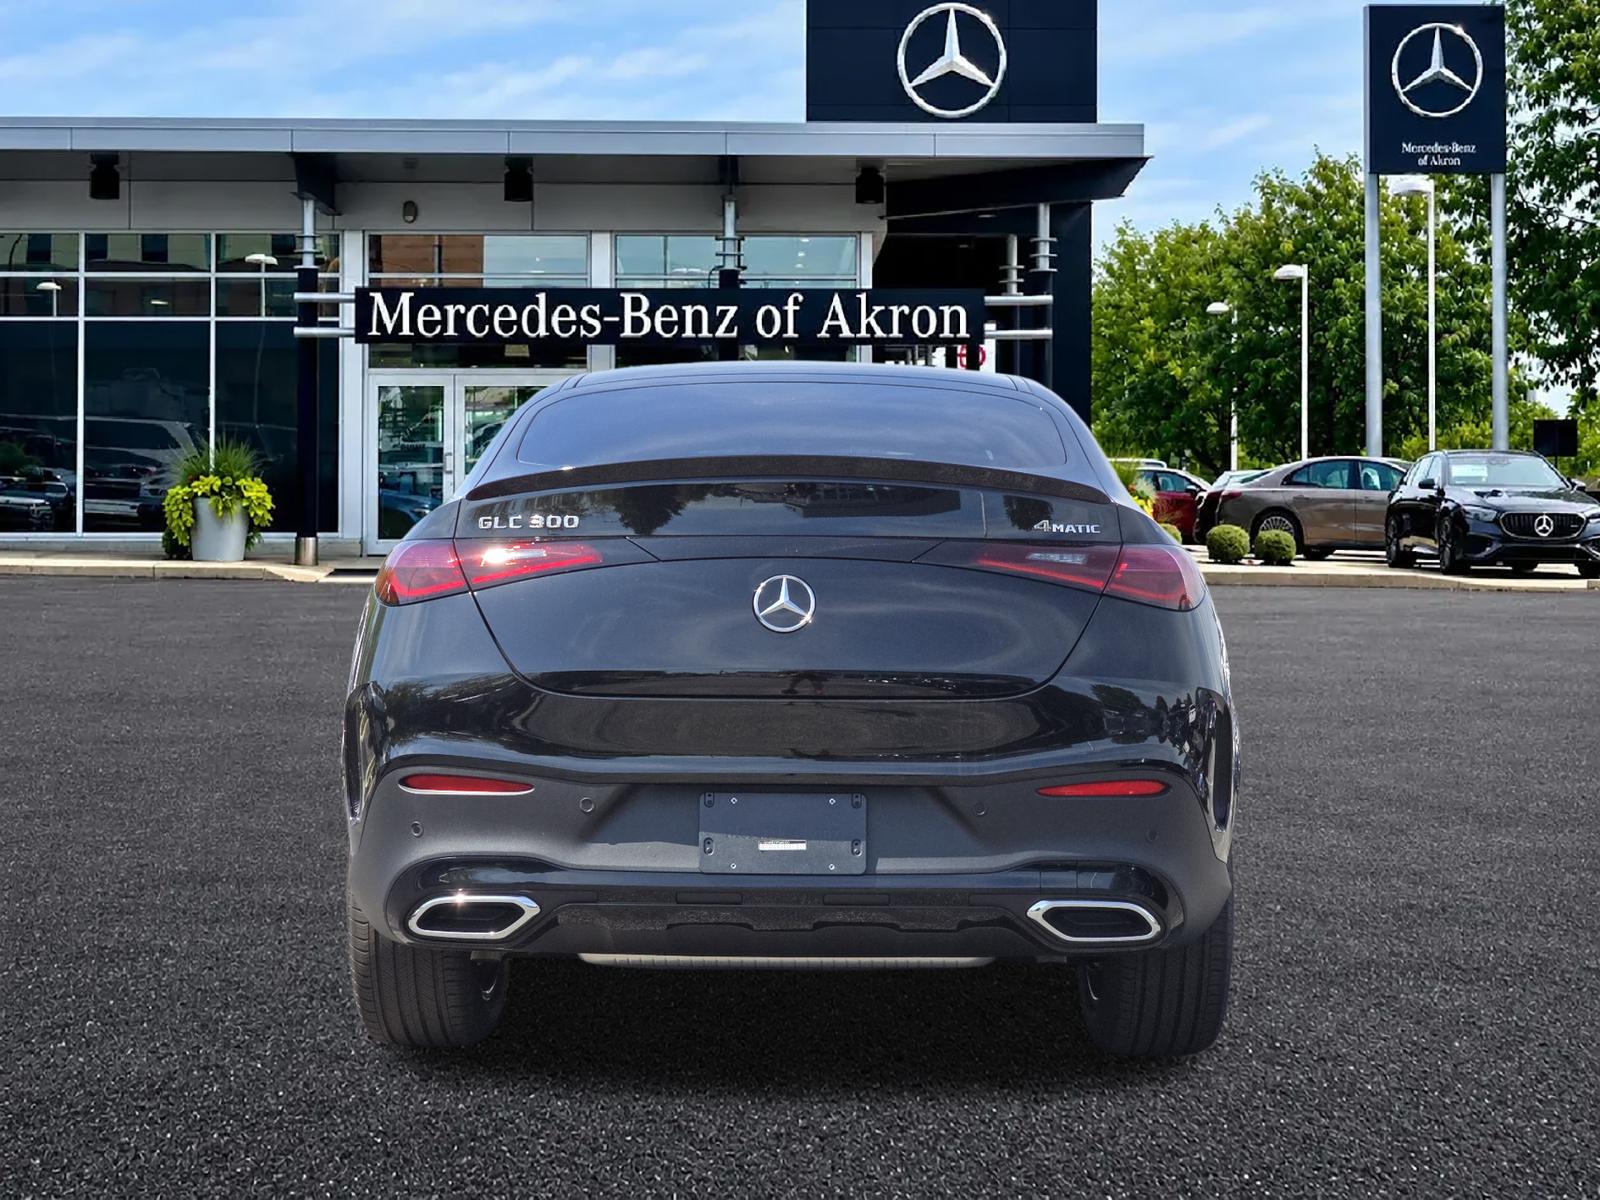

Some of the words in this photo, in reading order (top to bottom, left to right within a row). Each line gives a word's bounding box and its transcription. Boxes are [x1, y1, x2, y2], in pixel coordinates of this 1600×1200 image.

[1401, 141, 1477, 153] Mercedes-Benz
[1417, 154, 1428, 165] of
[1430, 154, 1461, 165] Akron
[368, 291, 739, 338] Mercedes-Benz
[755, 292, 804, 338] of
[817, 293, 970, 338] Akron
[478, 515, 522, 529] GLC
[529, 514, 580, 529] 300
[1033, 519, 1101, 533] 4MATIC
